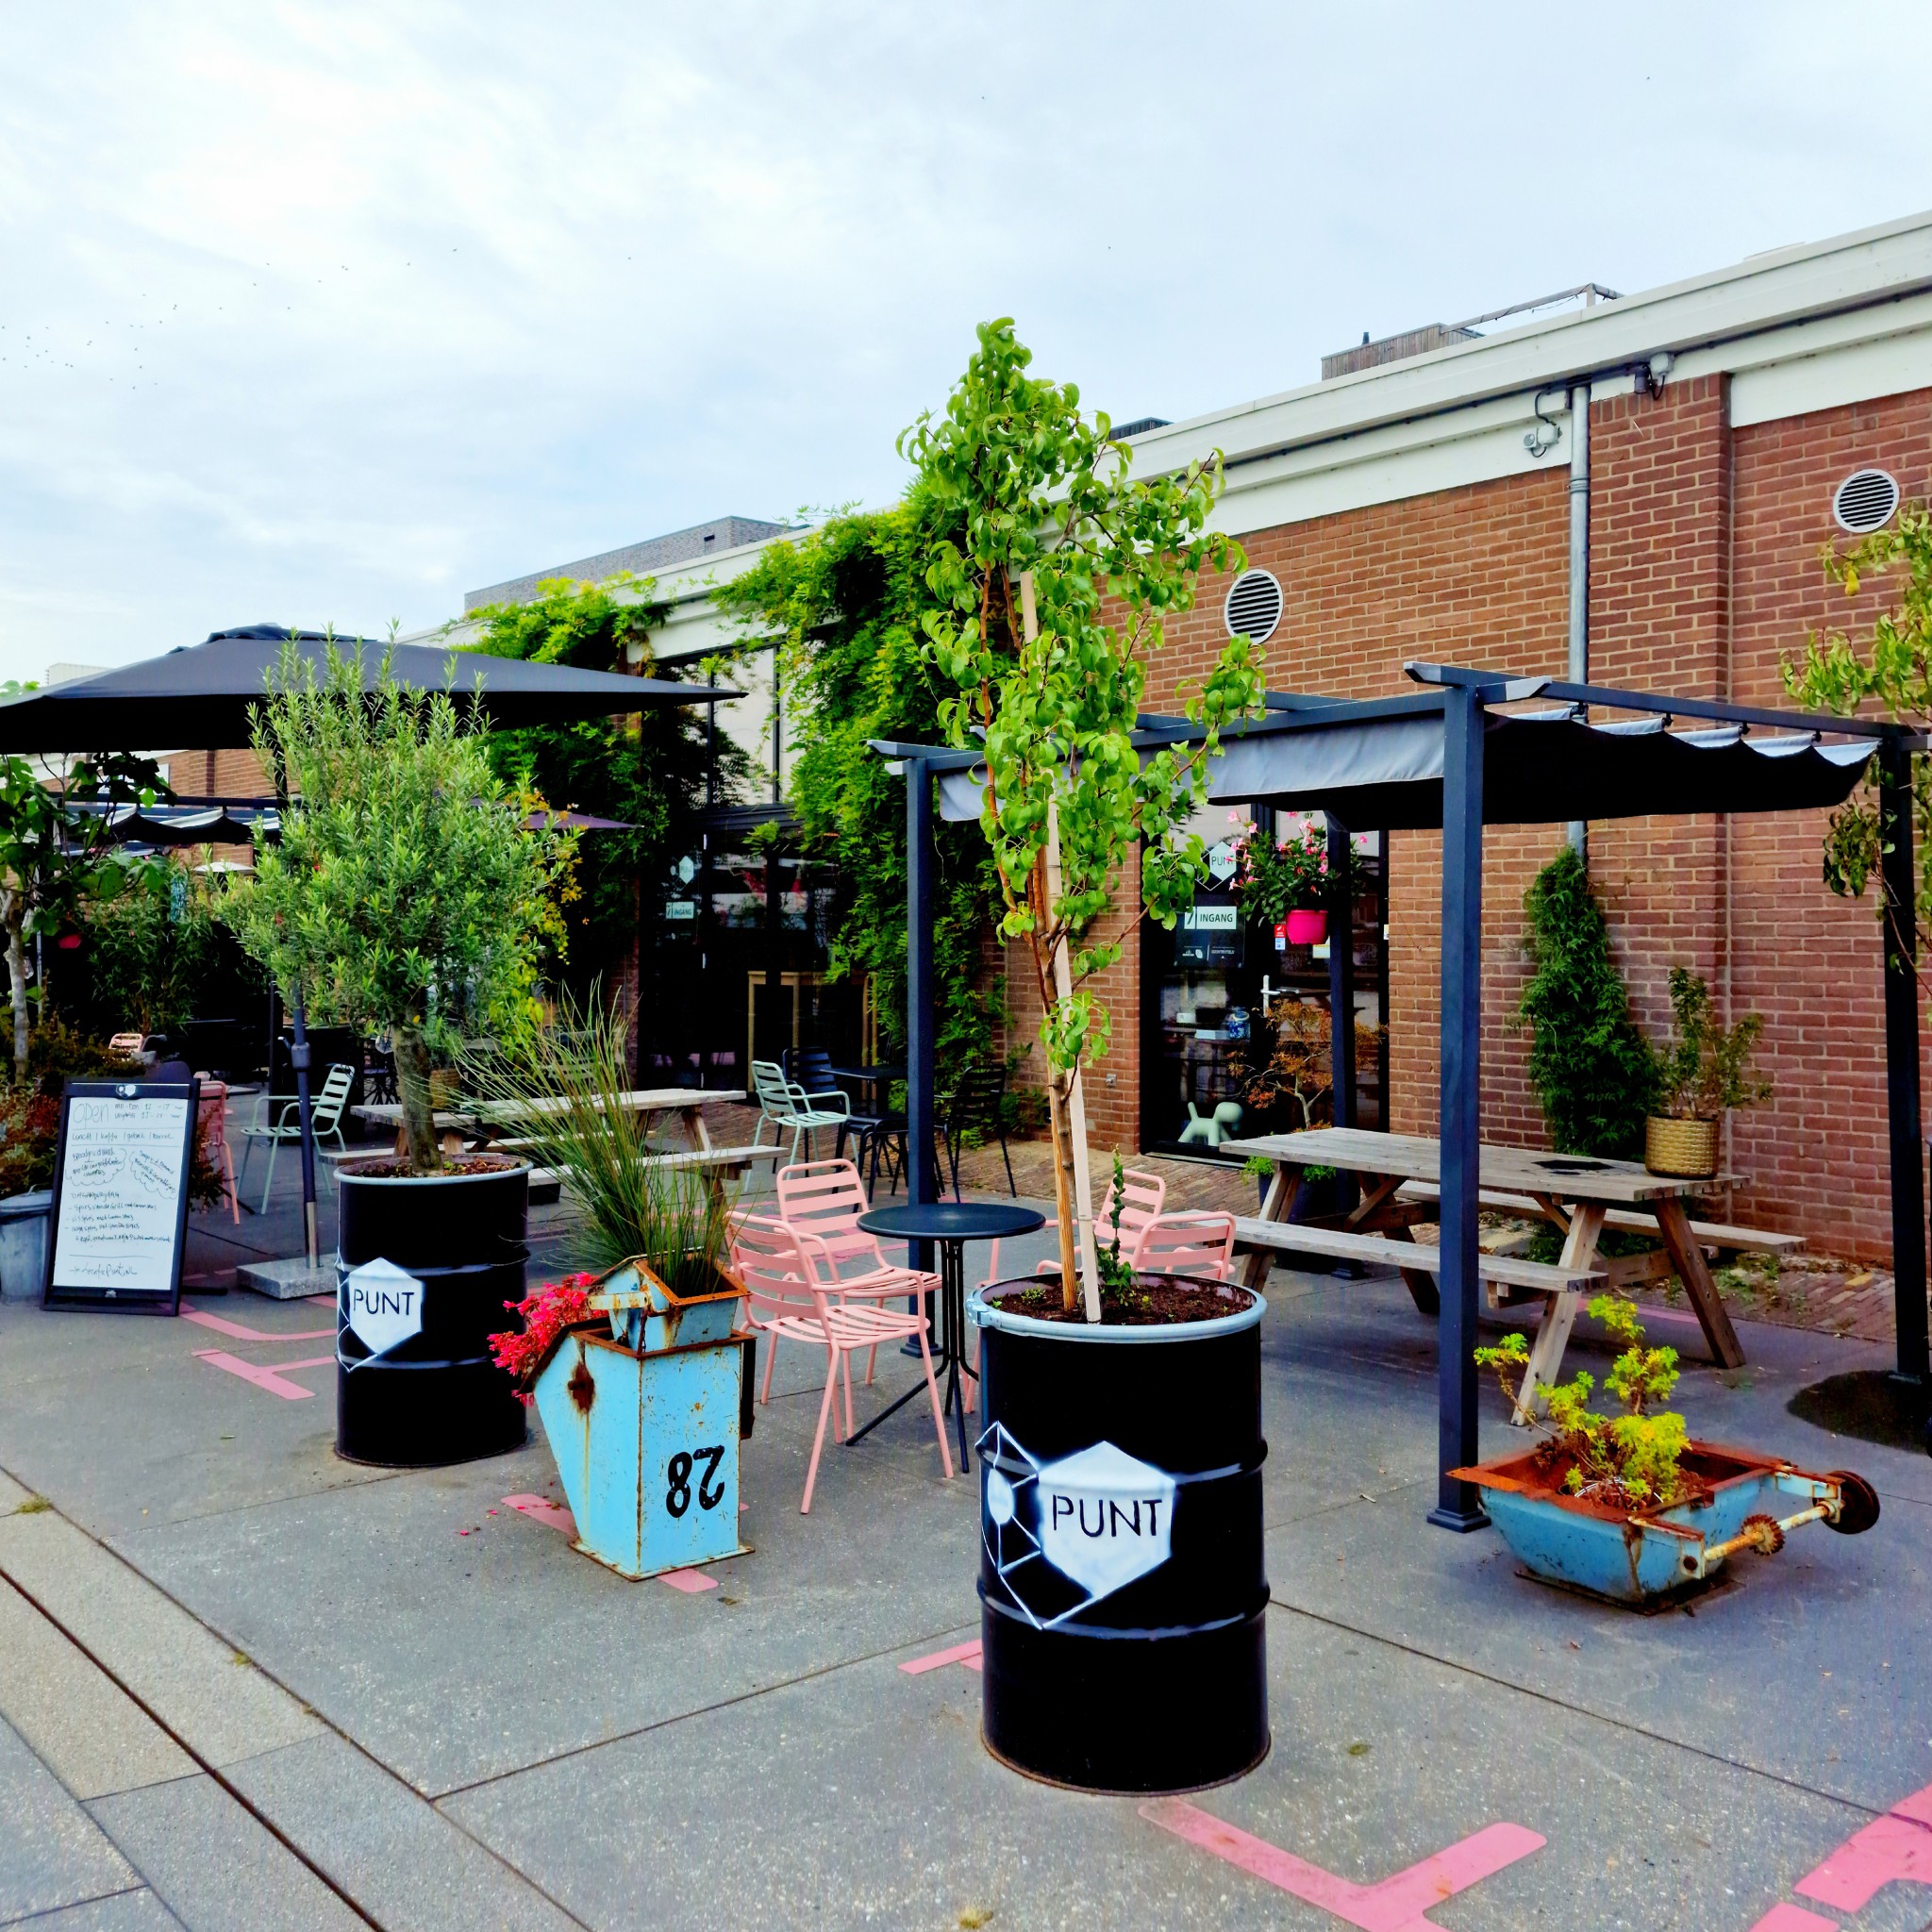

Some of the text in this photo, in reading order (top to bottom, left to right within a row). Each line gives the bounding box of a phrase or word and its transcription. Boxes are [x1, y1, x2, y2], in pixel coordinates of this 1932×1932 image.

[1200, 913, 1233, 923] INGANG
[353, 1289, 415, 1316] PUNT
[666, 1444, 725, 1519] 28
[1052, 1494, 1162, 1538] PUNT
